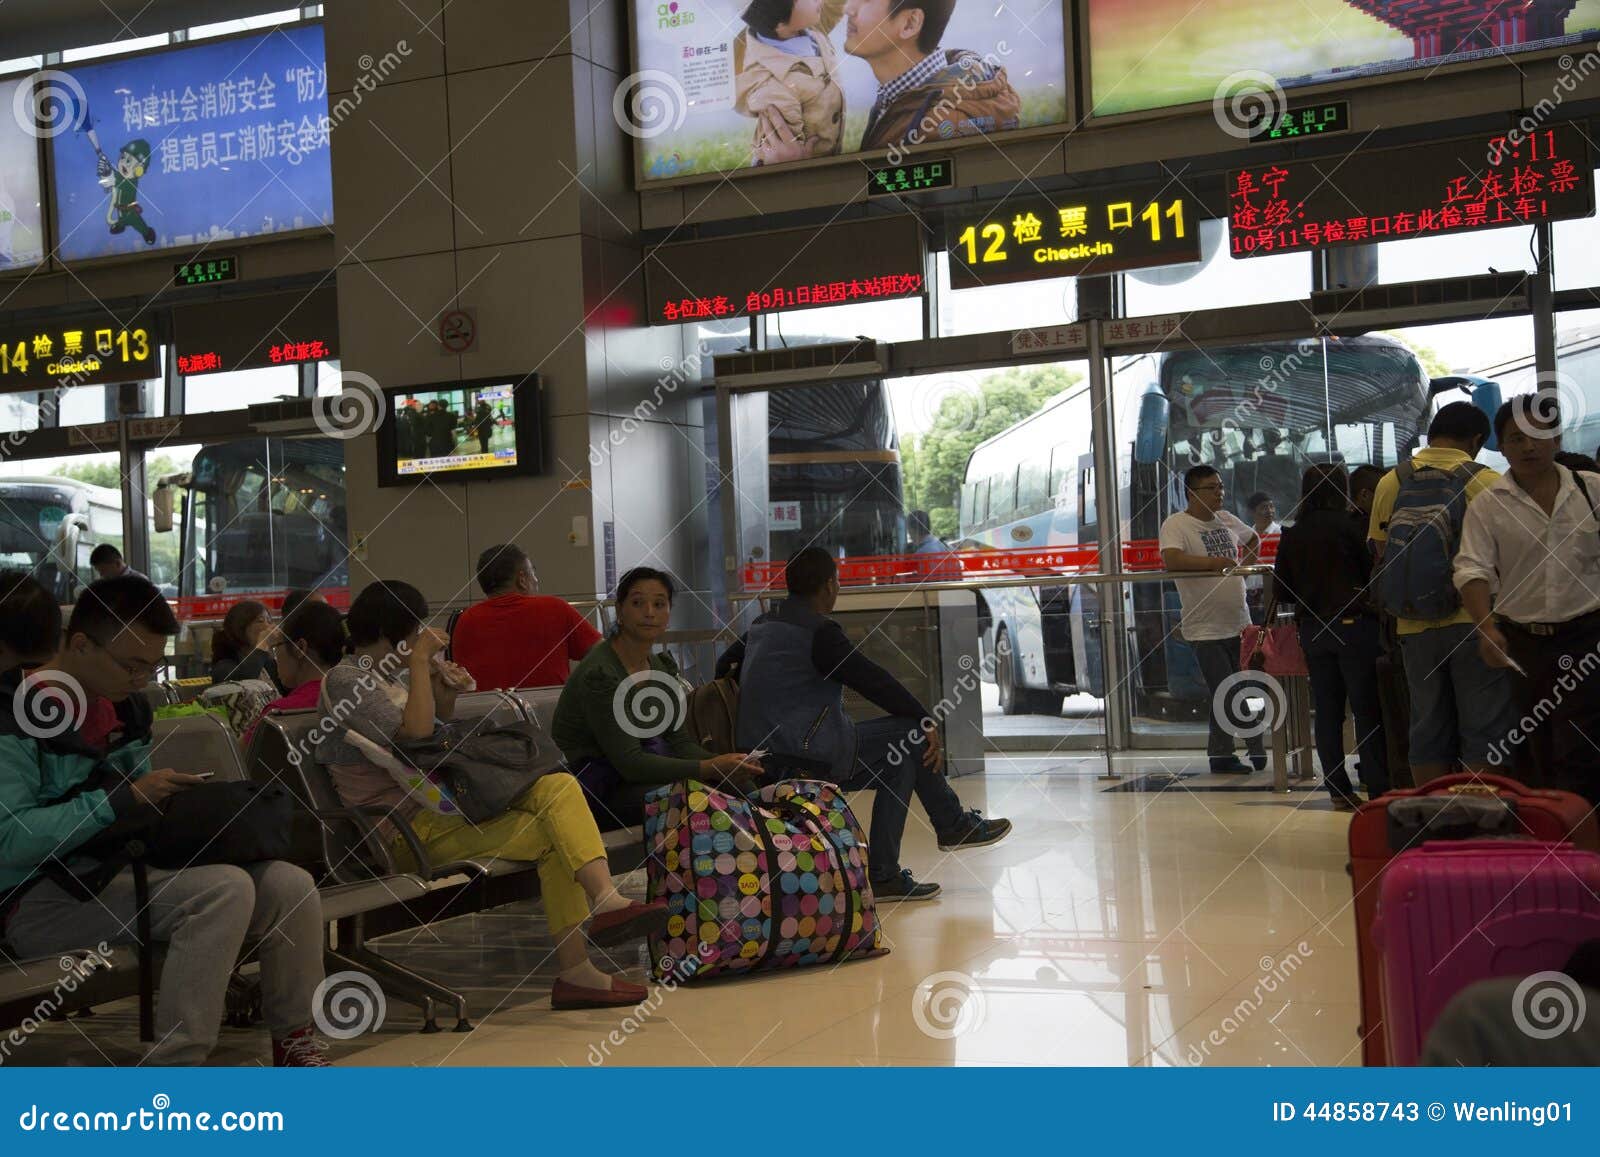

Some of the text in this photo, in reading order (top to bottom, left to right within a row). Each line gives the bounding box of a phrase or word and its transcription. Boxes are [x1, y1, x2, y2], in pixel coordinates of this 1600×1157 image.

[123, 72, 276, 132] 构建社会消防安全
[1270, 123, 1327, 138] EXIT
[877, 164, 942, 185] 安全出口
[886, 178, 933, 192] EXIT
[1231, 166, 1289, 201] 阜宁
[1441, 159, 1580, 204] 正在检票
[959, 200, 1185, 264] 12 检票口 11
[1033, 241, 1114, 263] Check-in
[1109, 318, 1179, 341] 送客止步
[0, 328, 149, 374] 14 检票口 13
[47, 358, 100, 375] Check-in
